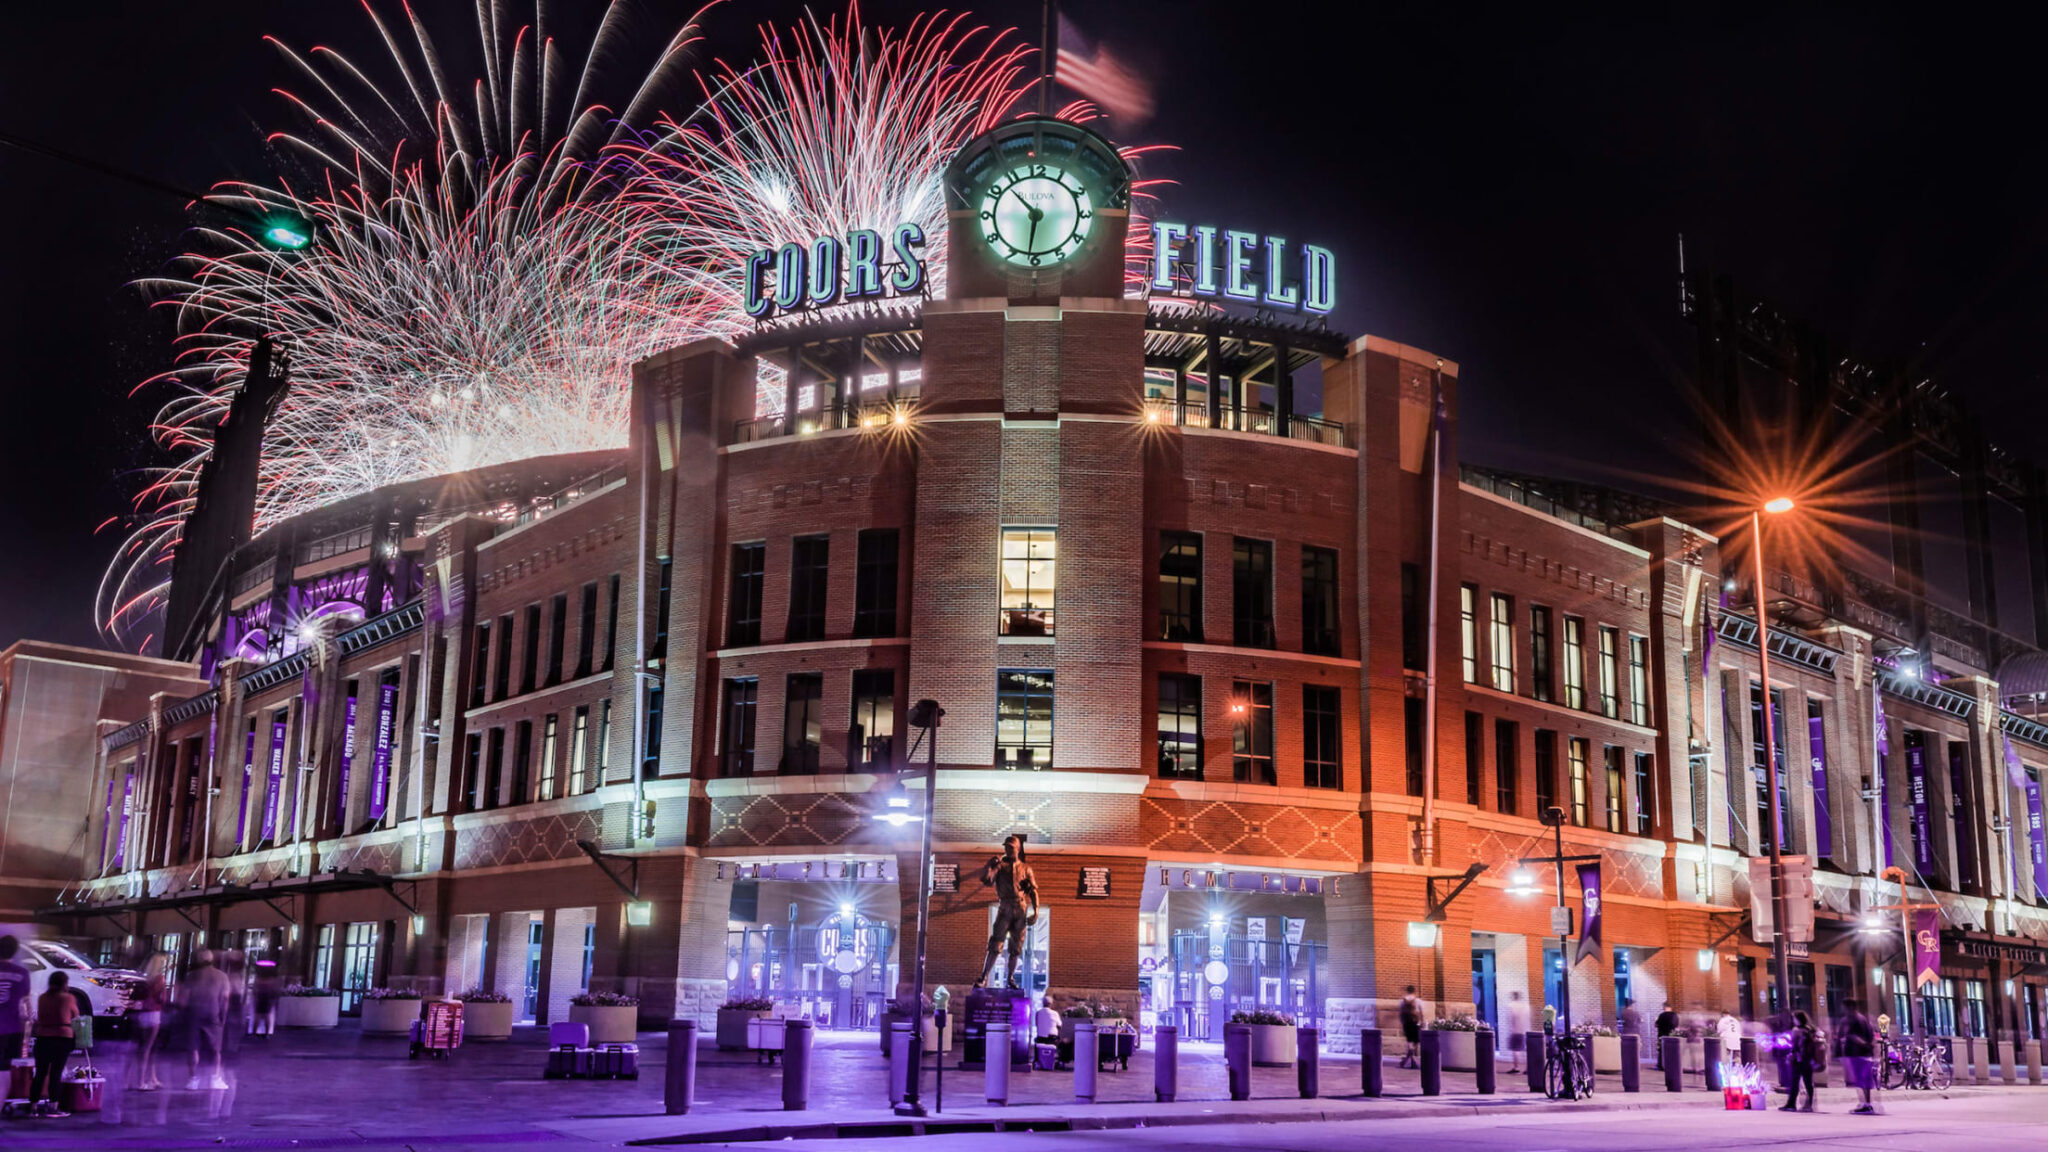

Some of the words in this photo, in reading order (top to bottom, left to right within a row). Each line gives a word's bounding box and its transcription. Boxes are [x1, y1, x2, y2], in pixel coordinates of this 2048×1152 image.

[1007, 169, 1019, 184] 11
[1029, 164, 1046, 178] 12
[986, 184, 1002, 200] 10
[1018, 191, 1055, 201] BULOVA
[1070, 186, 1086, 199] 2
[980, 210, 994, 221] 9
[1079, 209, 1092, 219] 3
[986, 232, 999, 243] 8
[1072, 232, 1085, 244] 4
[1004, 246, 1018, 260] 7
[1054, 247, 1066, 261] 5
[1029, 254, 1041, 267] 6
[1152, 221, 1336, 314] FIELD
[744, 222, 924, 318] COORS
[377, 709, 391, 750] GONZALEZ
[344, 724, 355, 758] ARENADO
[272, 748, 282, 775] WALKER
[1914, 775, 1925, 804] HELTON
[716, 861, 778, 880] HOME
[805, 861, 885, 879] PLATE
[1160, 868, 1236, 889] HOME
[1261, 873, 1342, 896] PLATE
